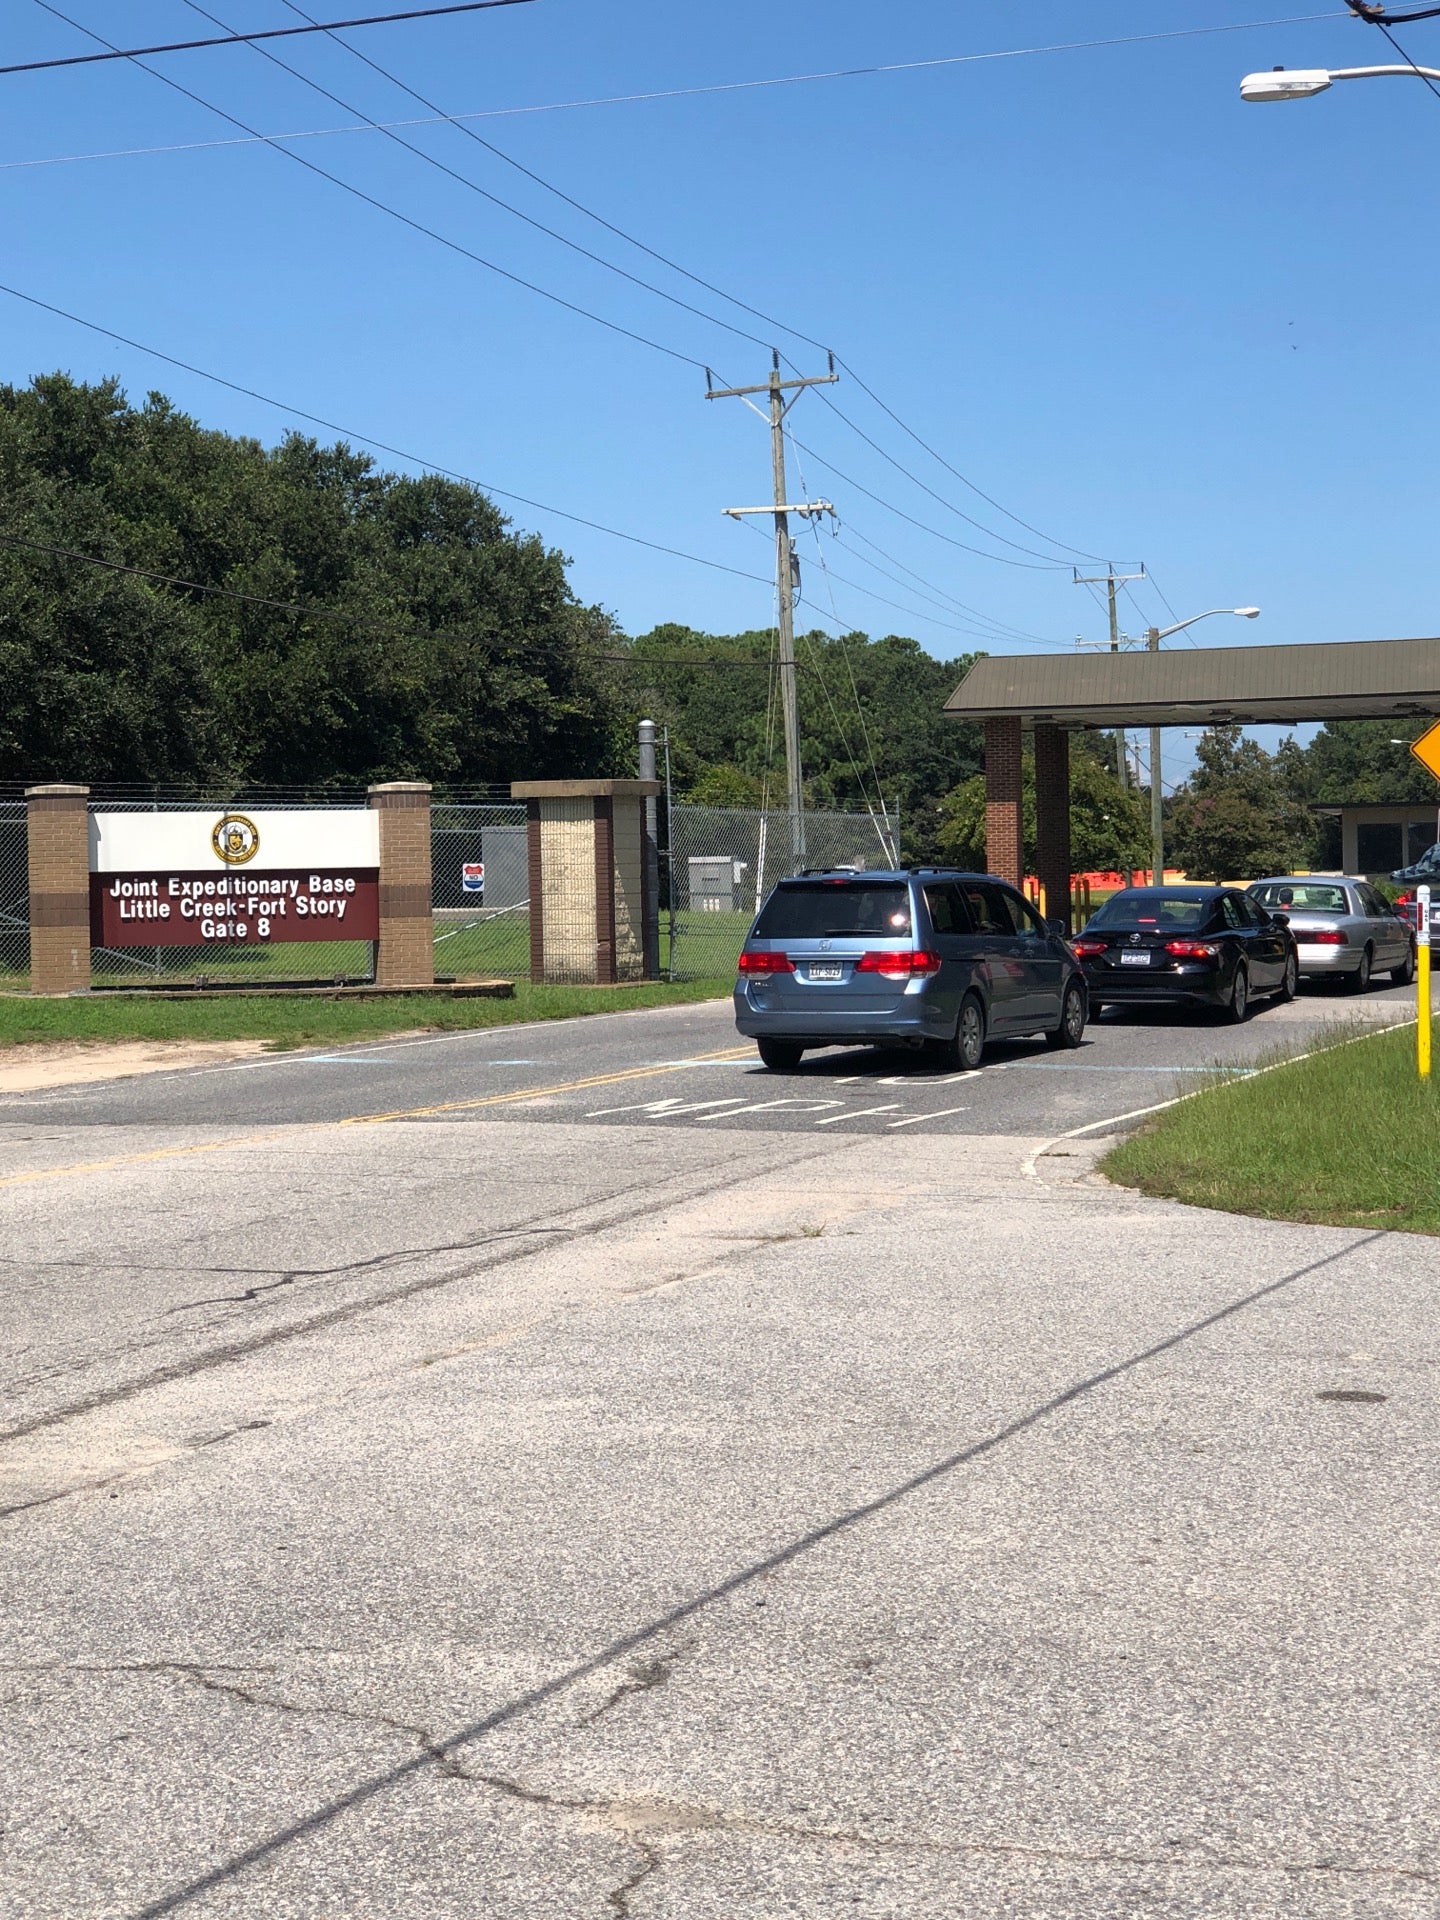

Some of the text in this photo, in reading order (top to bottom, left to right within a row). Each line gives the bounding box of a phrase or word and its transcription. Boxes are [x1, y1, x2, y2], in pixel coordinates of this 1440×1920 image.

[110, 875, 356, 899] Joint Expeditionary Base
[120, 896, 347, 918] Little Creek-Fort Story
[201, 917, 270, 938] Gate 8
[585, 1098, 971, 1128] MPH
